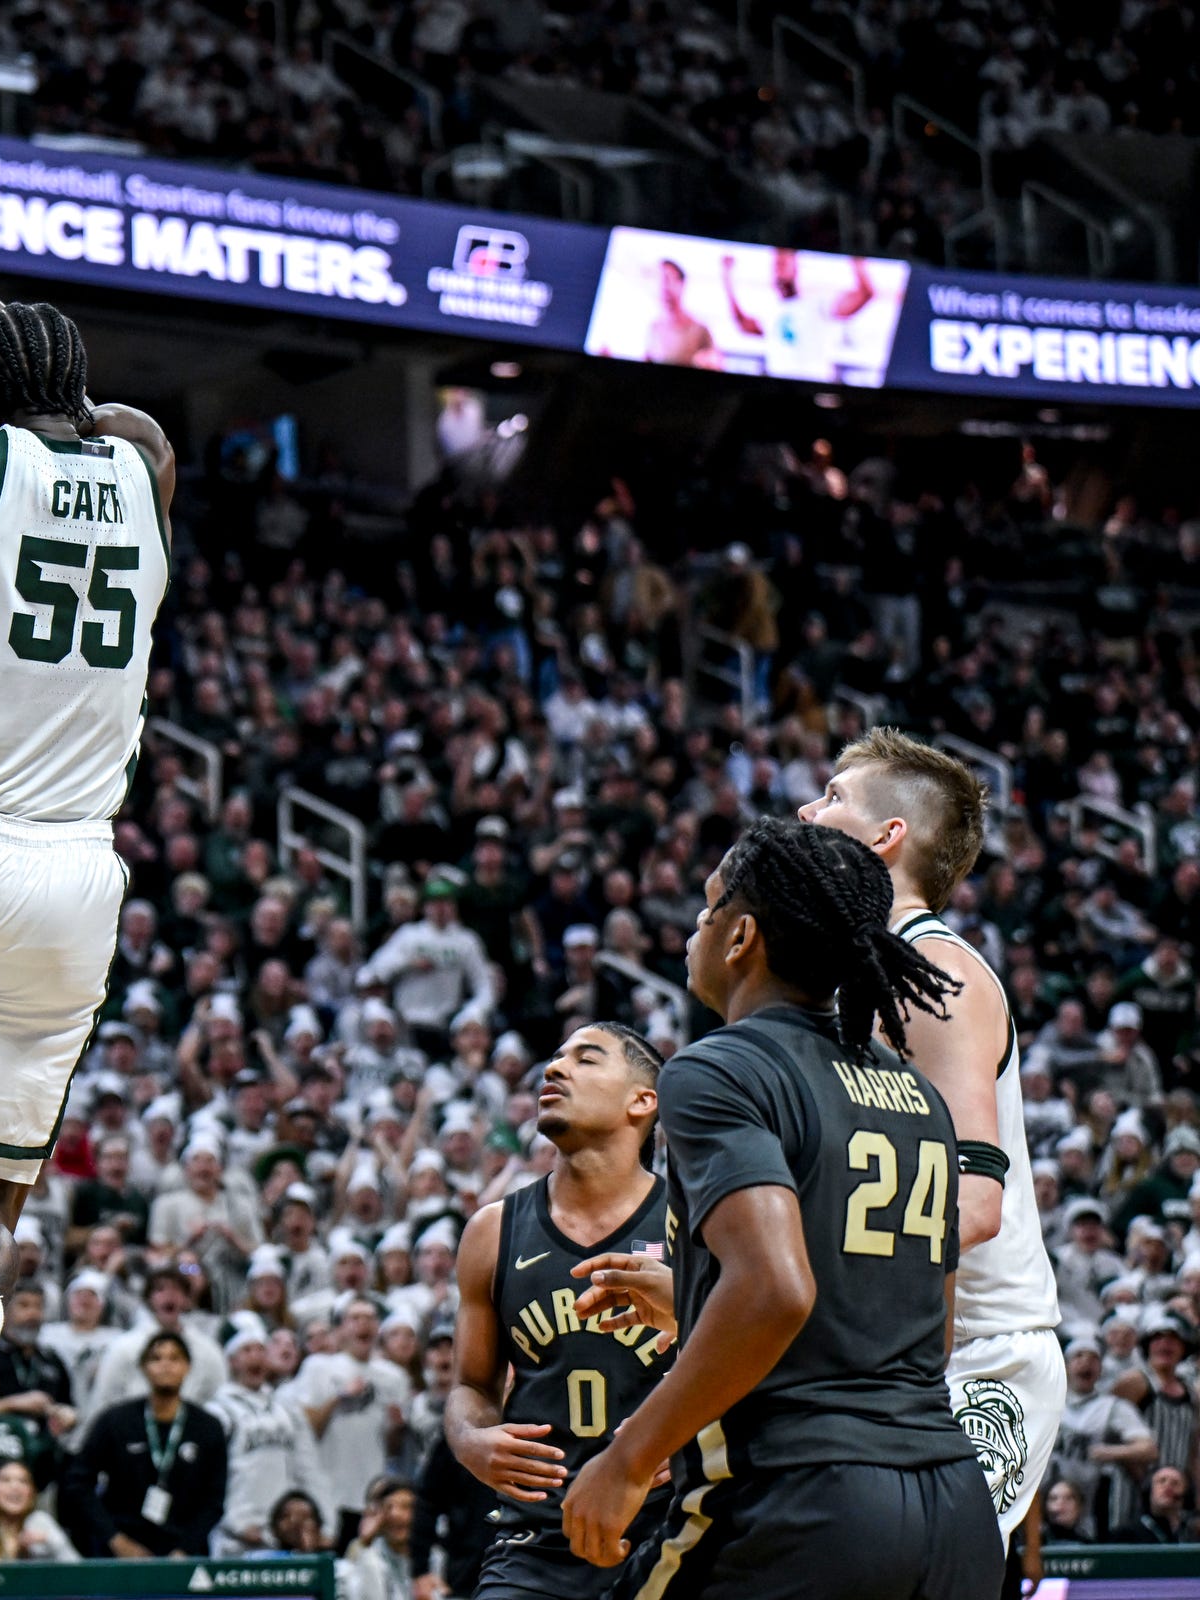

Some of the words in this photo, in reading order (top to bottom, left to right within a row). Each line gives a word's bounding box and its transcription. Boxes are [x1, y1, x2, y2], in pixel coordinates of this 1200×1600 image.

[125, 174, 227, 218] Spartan
[226, 189, 283, 228] fans
[283, 197, 352, 237] know
[352, 209, 400, 245] the
[131, 212, 407, 306] MATTERS.
[928, 284, 1000, 319] When
[1001, 290, 1023, 322] it
[1022, 297, 1103, 328] comes
[1104, 299, 1134, 330] to
[8, 534, 140, 669] 55
[832, 1061, 930, 1115] HARRIS
[843, 1130, 948, 1264] 24
[567, 1369, 606, 1438] 0
